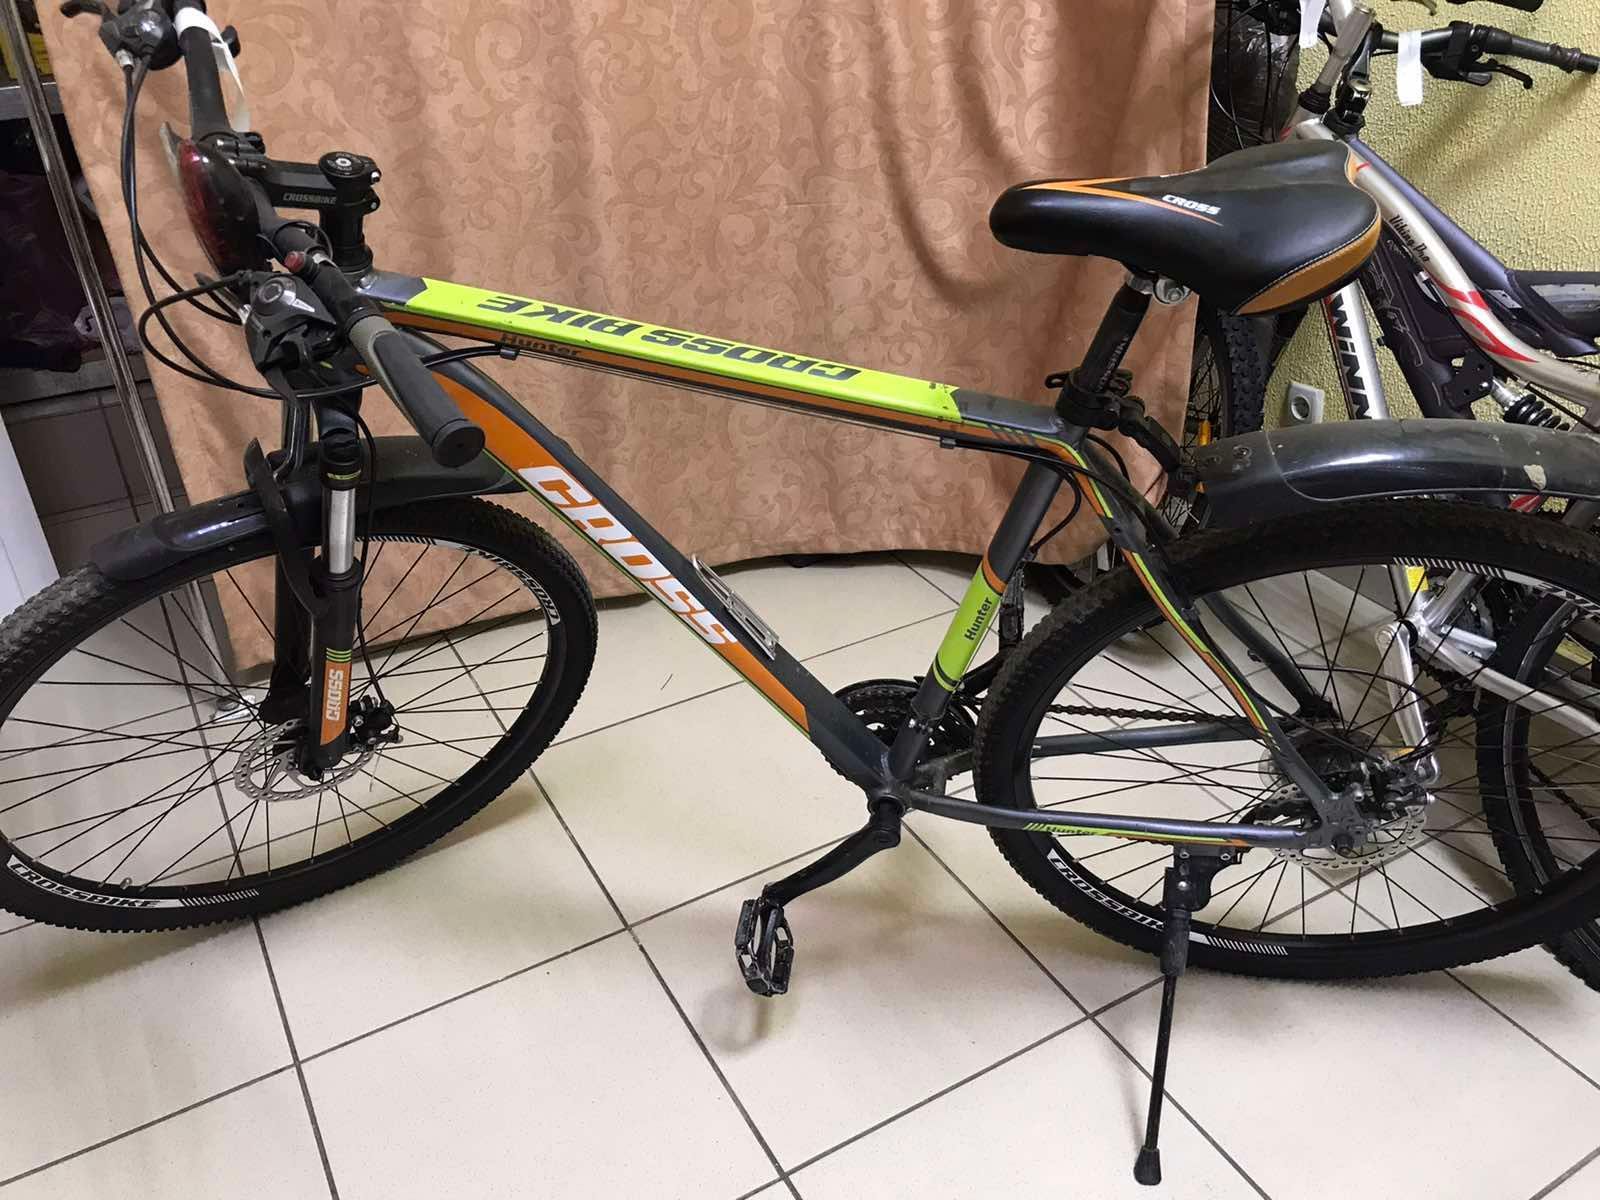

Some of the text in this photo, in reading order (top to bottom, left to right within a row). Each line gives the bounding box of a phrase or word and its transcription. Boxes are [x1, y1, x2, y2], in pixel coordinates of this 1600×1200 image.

[283, 192, 337, 205] CROSSBIKE
[1162, 194, 1221, 215] CROSS
[1389, 214, 1430, 262] Viking Pro
[477, 296, 861, 381] CROSS BIKE
[501, 333, 582, 356] Hunter
[518, 466, 738, 644] CROSS
[964, 597, 992, 640] Hunter
[326, 669, 344, 721] CROSS
[1046, 826, 1096, 836] Hunter
[10, 863, 160, 908] CROSSBIKE
[1051, 858, 1165, 930] CROSSBIK
